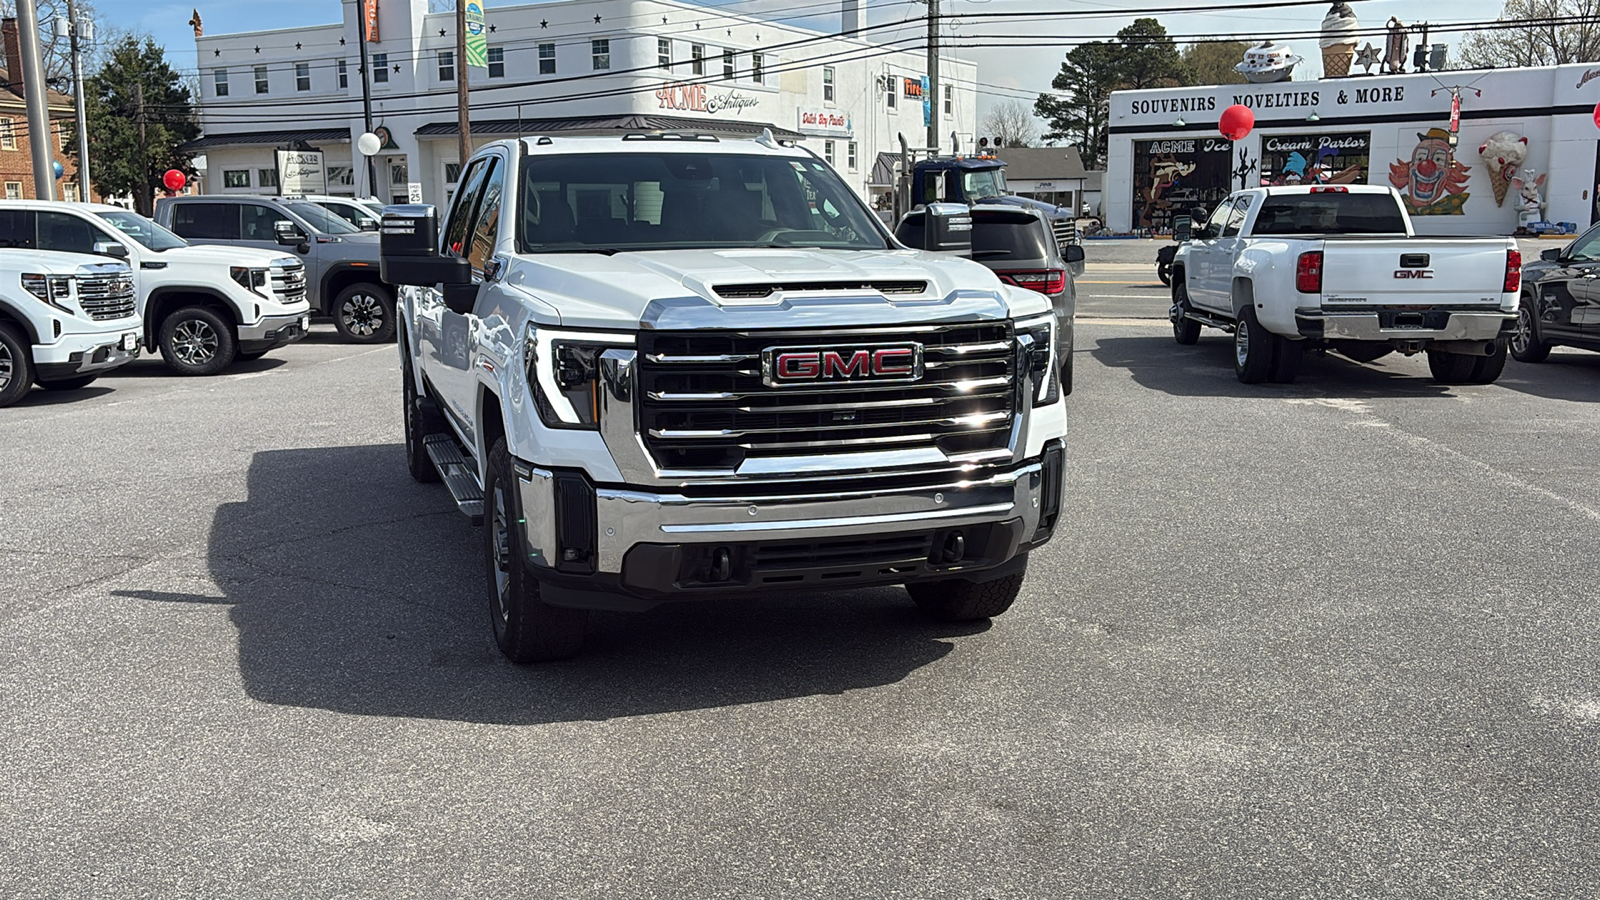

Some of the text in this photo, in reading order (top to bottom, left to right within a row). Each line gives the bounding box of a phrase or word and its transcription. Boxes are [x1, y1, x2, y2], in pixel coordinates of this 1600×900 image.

[656, 81, 707, 112] ACME
[1131, 86, 1404, 115] SOUVENIRS NOVELTIES & MORE
[1149, 139, 1231, 154] ACME Ice
[1266, 136, 1367, 151] Cream Parlor
[410, 193, 421, 201] 25
[1393, 270, 1434, 279] GMC
[776, 348, 913, 379] GMC
